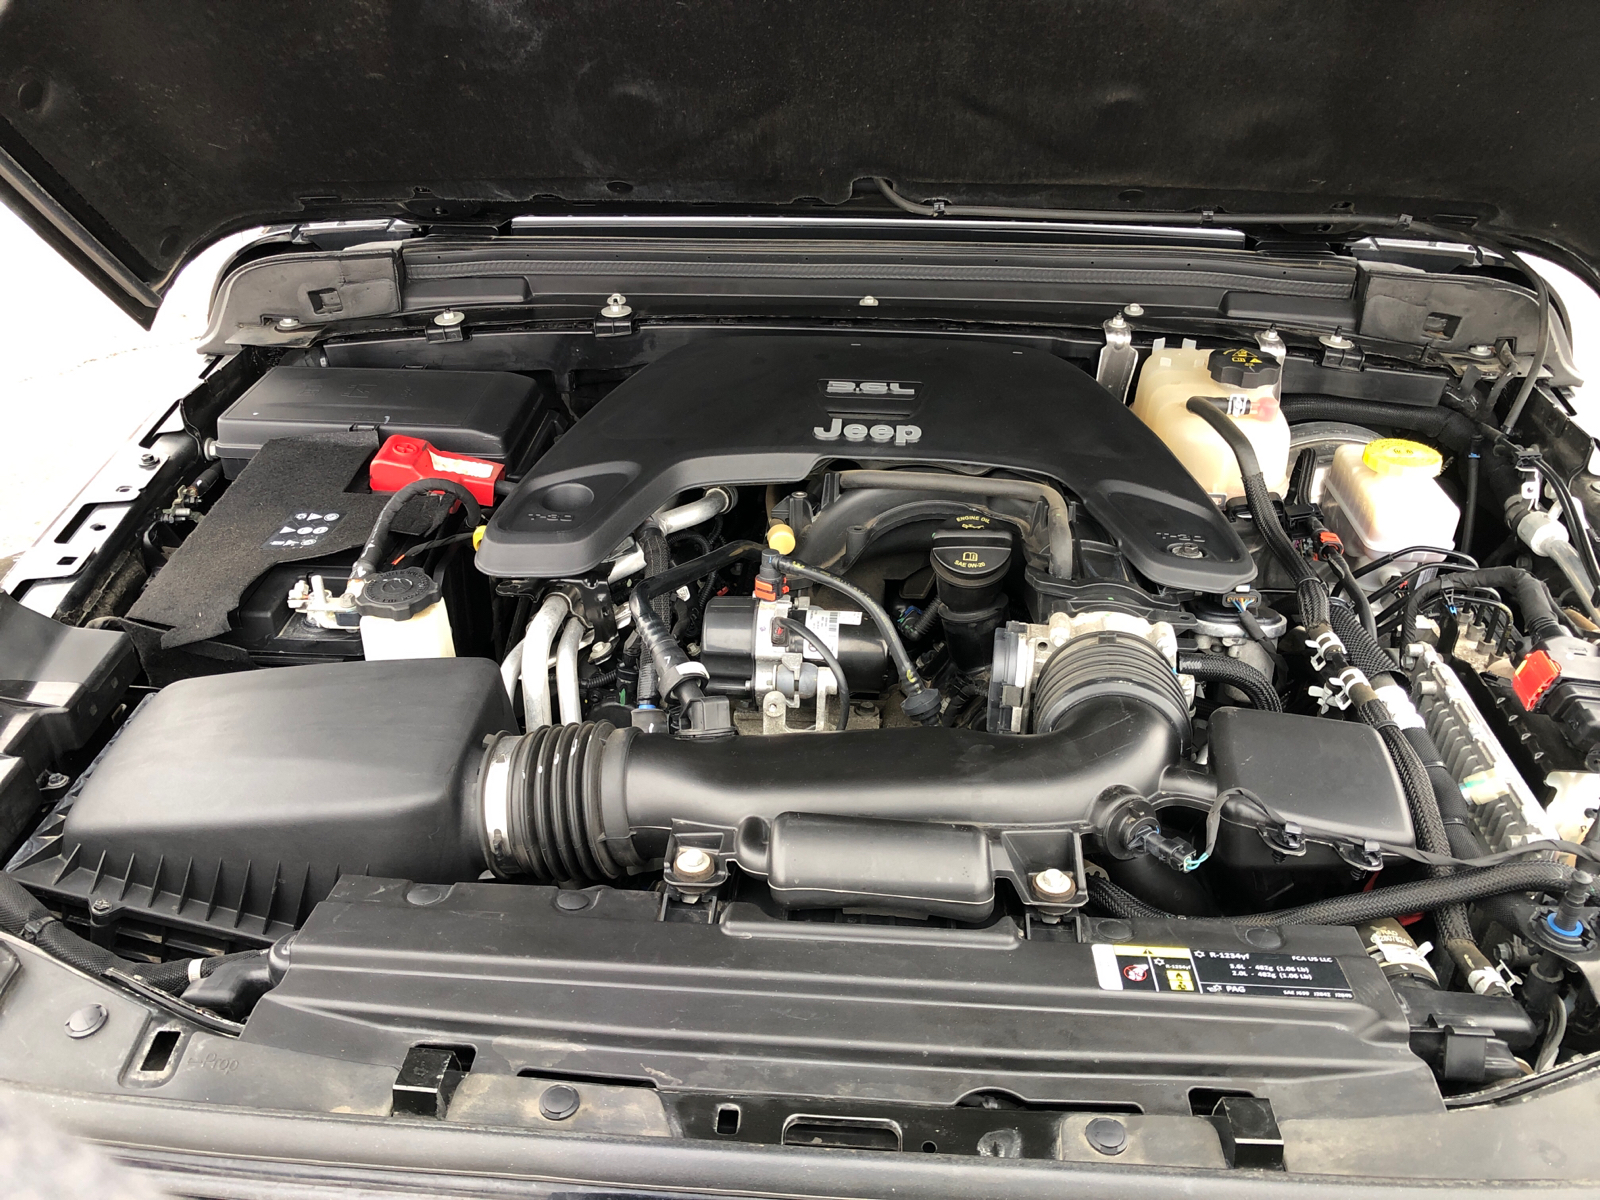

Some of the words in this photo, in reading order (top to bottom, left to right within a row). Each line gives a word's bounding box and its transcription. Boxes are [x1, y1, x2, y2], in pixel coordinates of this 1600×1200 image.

[826, 381, 915, 395] 3.6L
[812, 418, 922, 446] Jeep
[980, 516, 991, 524] OIL
[954, 560, 967, 568] SAE
[1209, 951, 1250, 960] R-1234yf
[1254, 964, 1274, 972] 482g
[1257, 971, 1277, 979] 482g
[1226, 985, 1246, 993] PAG
[202, 1052, 240, 1075] Prop
